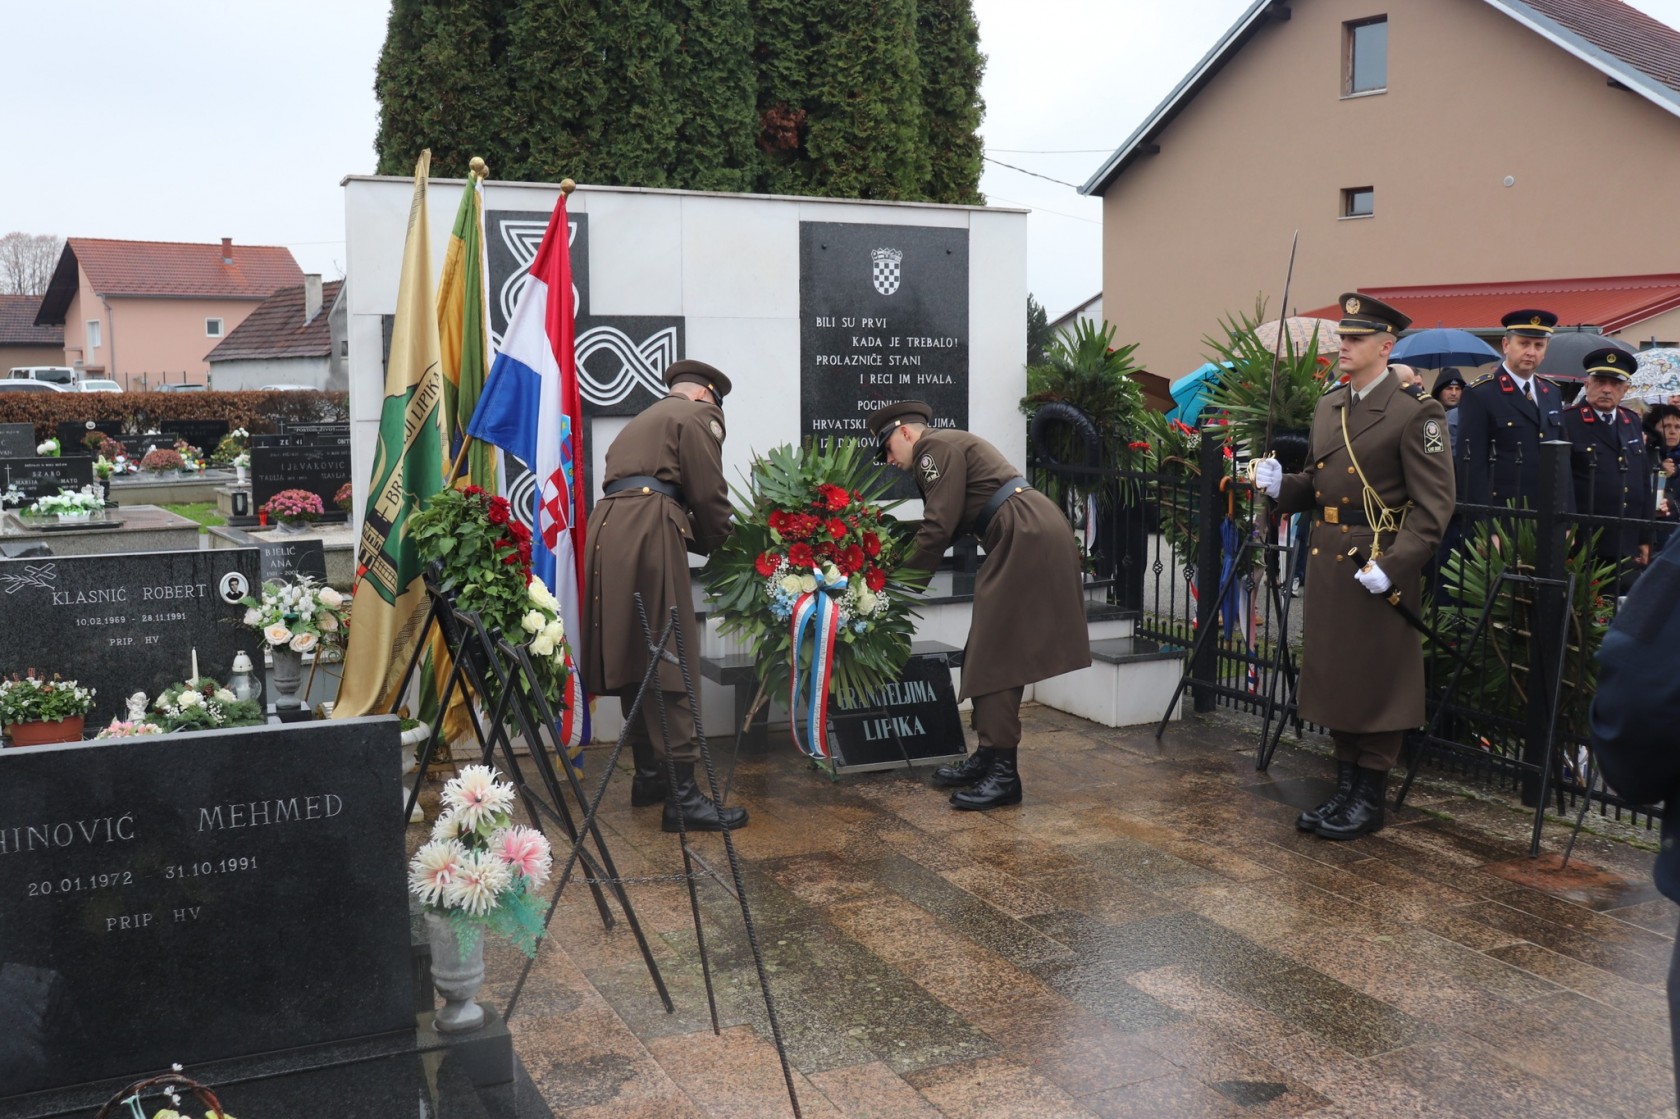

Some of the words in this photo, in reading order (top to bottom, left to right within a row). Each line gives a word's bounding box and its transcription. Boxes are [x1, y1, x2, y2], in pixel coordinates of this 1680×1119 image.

[816, 317, 835, 328] BILI
[842, 317, 856, 328] SU
[862, 318, 887, 329] PRVI
[852, 336, 883, 347] KADA
[889, 337, 901, 347] JE
[907, 337, 958, 348] TREBALO!
[816, 354, 883, 366] PROLAZNIČE
[889, 355, 921, 366] STANI
[860, 374, 864, 384] I
[870, 374, 893, 384] RECI
[899, 374, 911, 384] IM
[918, 374, 956, 384] HVALA.
[415, 372, 440, 420] LIPIKA
[265, 546, 296, 556] BJELIĆ
[271, 560, 292, 568] ANA
[52, 585, 127, 606] KLASNIĆ
[142, 584, 207, 600] ROBERT
[76, 615, 126, 626] 10.02.1969
[141, 612, 186, 623] 28.11.1991
[145, 635, 160, 645] HV
[862, 715, 926, 741] LIPIKA
[197, 793, 343, 832] MEHMED
[28, 871, 133, 897] 20.01.1972
[165, 856, 257, 879] 31.10.1991
[173, 906, 201, 922] HV
